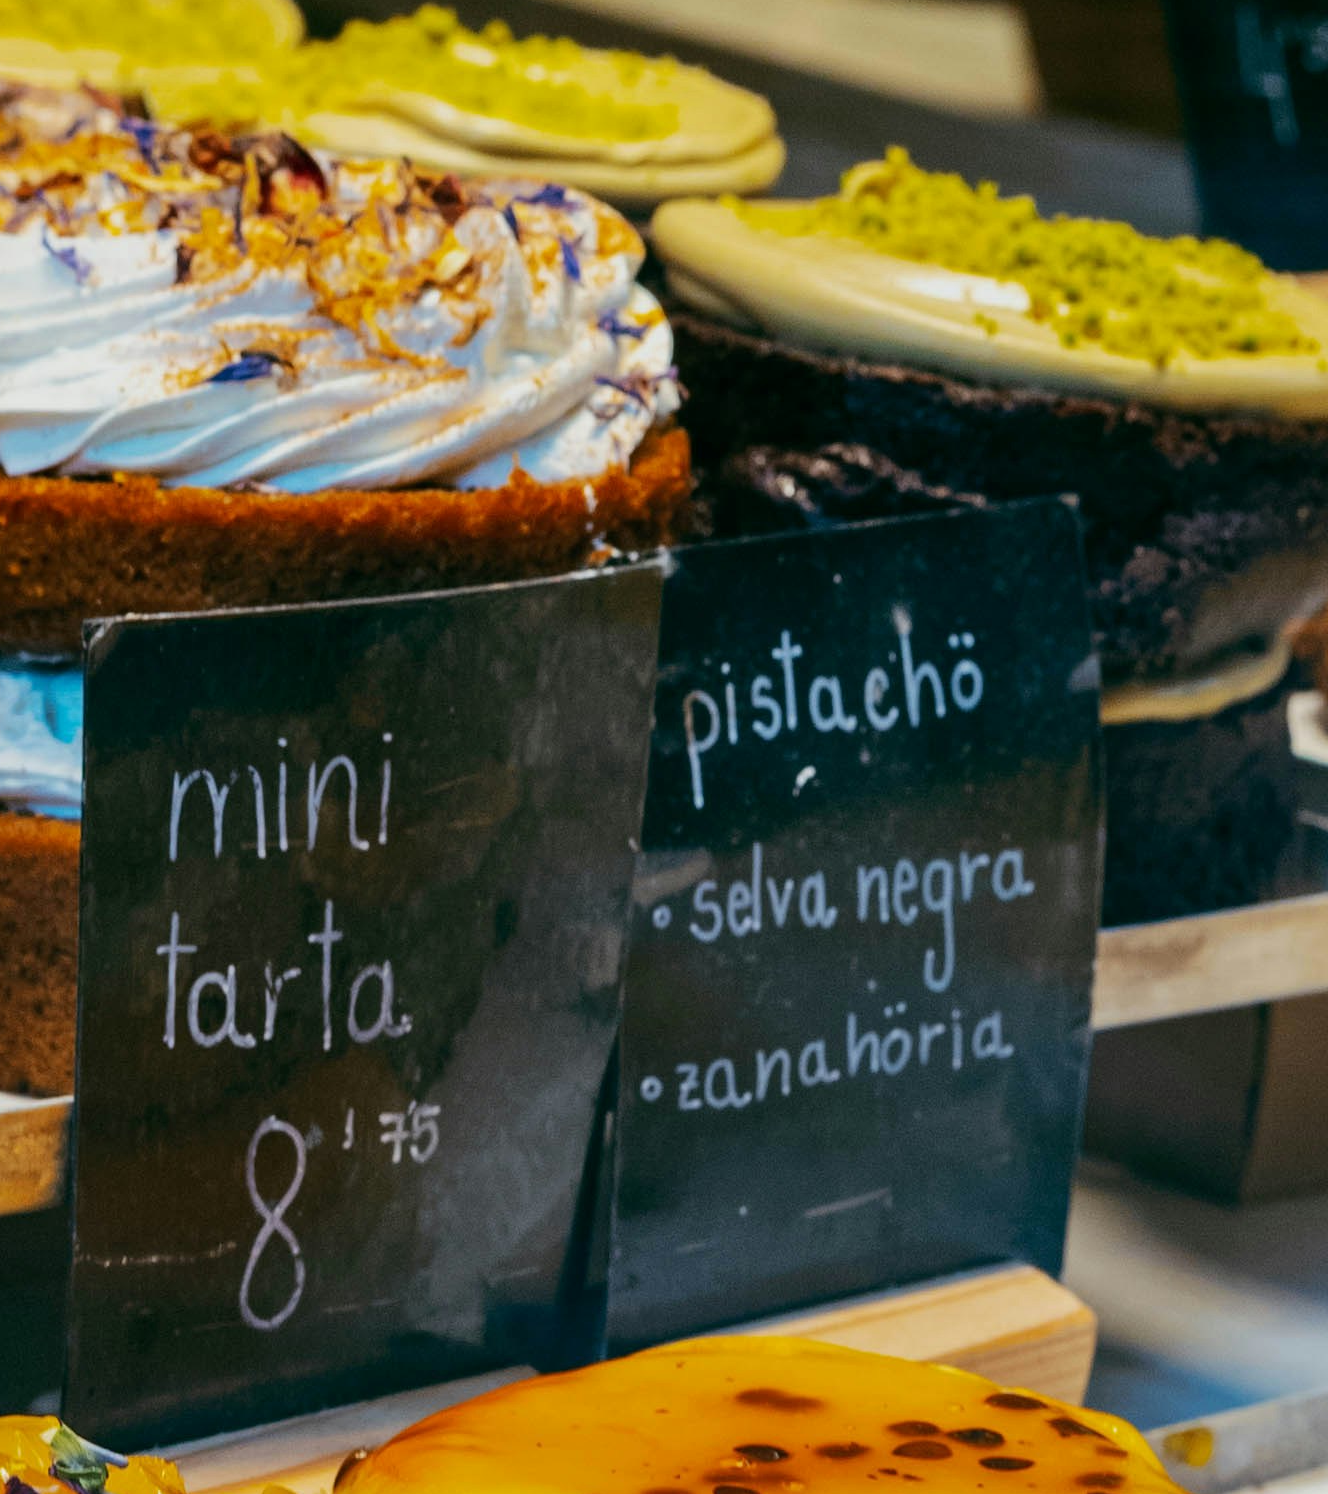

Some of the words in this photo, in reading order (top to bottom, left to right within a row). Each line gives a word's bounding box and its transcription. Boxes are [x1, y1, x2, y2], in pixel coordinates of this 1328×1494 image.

[168, 732, 394, 862] mini
[155, 899, 414, 1052] tarta
[690, 841, 839, 942] selva
[857, 848, 1036, 994] negra
